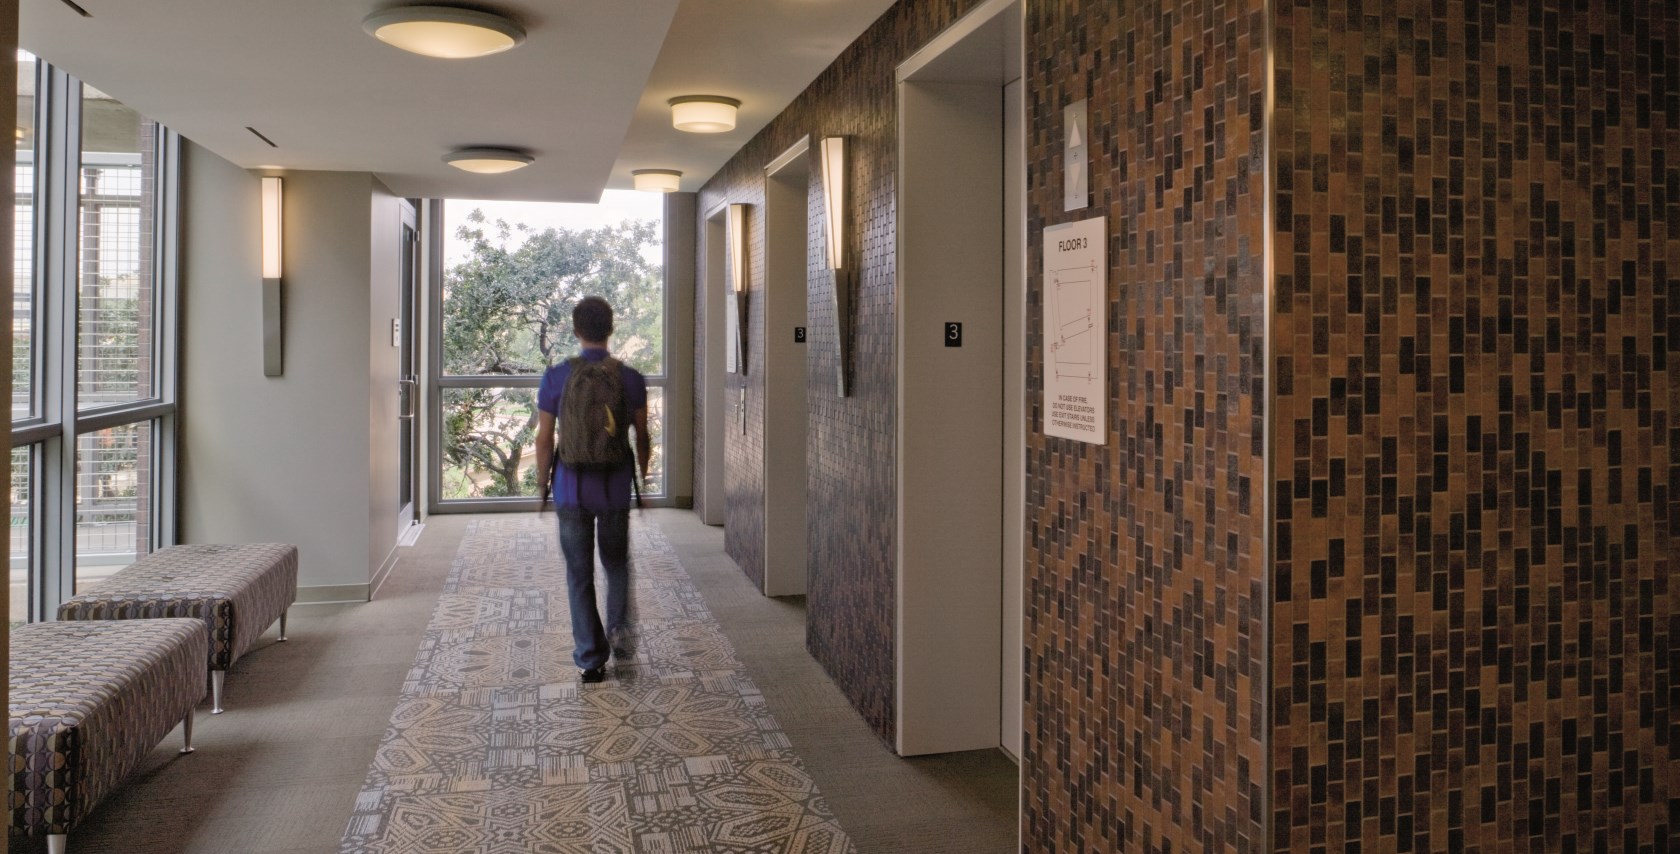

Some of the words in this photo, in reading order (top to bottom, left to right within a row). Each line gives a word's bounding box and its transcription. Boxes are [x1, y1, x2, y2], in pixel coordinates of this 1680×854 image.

[1058, 238, 1082, 252] FLOOR
[1083, 238, 1088, 248] 3
[797, 328, 804, 338] 3
[949, 324, 958, 340] 3
[1074, 405, 1095, 414] ELEVATORS
